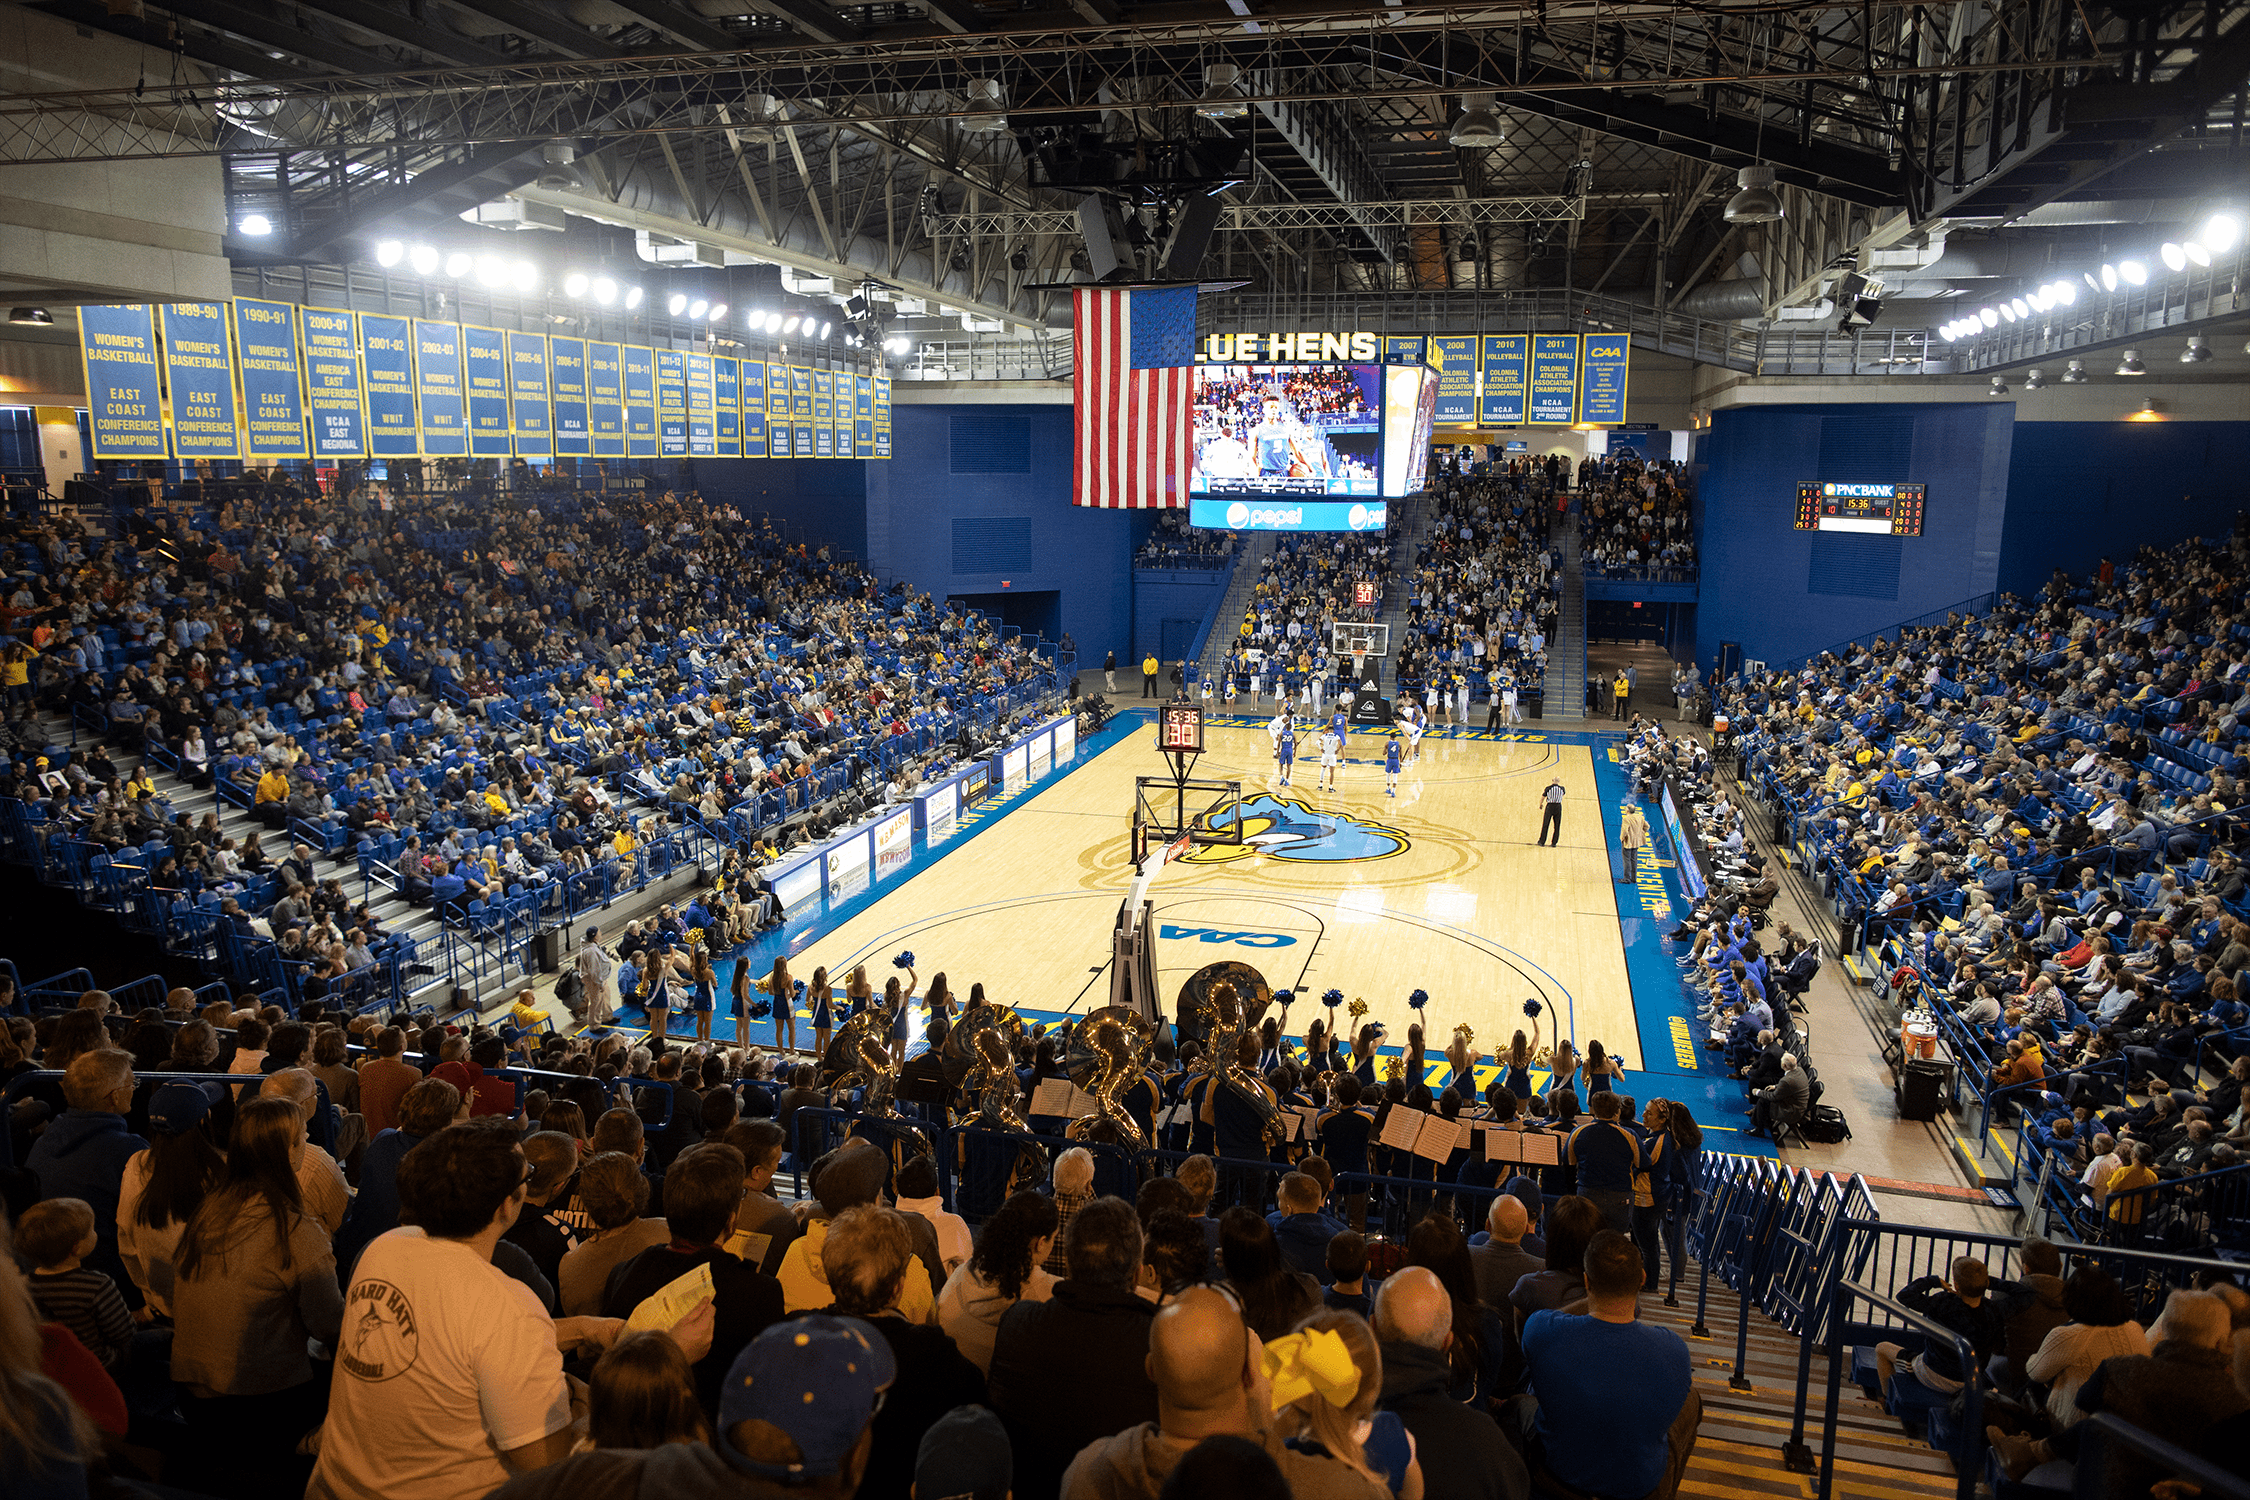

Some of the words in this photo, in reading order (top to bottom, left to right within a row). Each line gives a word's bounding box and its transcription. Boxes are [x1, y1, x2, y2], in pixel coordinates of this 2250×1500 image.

[172, 304, 218, 319] 1989-90
[244, 309, 286, 325] 1990-91
[309, 316, 347, 331] 2000-01
[94, 333, 144, 348] WOMEN'S
[312, 335, 348, 347] WOMEN'S
[368, 337, 404, 351] 2001-02
[1194, 333, 1259, 361] UE
[1269, 332, 1376, 361] HENS
[1546, 340, 1565, 348] 2011
[175, 340, 220, 354] WOMEN'S
[248, 345, 288, 358] WOMEN'S
[307, 347, 355, 359] BASKETBALL
[422, 342, 454, 355] 2002-03
[1591, 348, 1621, 357] CAA
[88, 349, 153, 364] BASKETBALL
[470, 347, 500, 360] 2004-05
[1441, 353, 1474, 361] OLLEYBALL
[1537, 352, 1574, 360] VOLLEYBALL
[170, 355, 228, 369] BASKETBALL
[243, 359, 296, 372] BASKETBALL
[316, 364, 350, 376] AMERICA
[372, 370, 406, 381] WOMEN'S
[324, 376, 343, 387] EAST
[425, 373, 455, 384] WOMEN'S
[473, 377, 501, 388] WOMEN'S
[110, 388, 140, 400] EAST
[311, 387, 358, 399] CONFERENCE
[369, 382, 412, 394] BASKETBALL
[422, 385, 461, 396] BASKETBALL
[470, 388, 506, 399] BASKETBALL
[190, 392, 216, 403] EAST
[261, 394, 286, 404] EAST
[107, 404, 146, 416] COAST
[314, 399, 358, 410] CHAMPIONS
[187, 407, 221, 418] COAST
[259, 408, 291, 418] COAST
[382, 414, 403, 423] WNIT
[97, 419, 159, 431] CONFERENCE
[326, 416, 350, 427] NCAA
[434, 415, 452, 424] WNIT
[480, 417, 499, 426] WNIT
[177, 421, 233, 433] CONFERENCE
[251, 422, 301, 432] CONFERENCE
[329, 428, 348, 438] EAST
[101, 434, 158, 446] CHAMPIONS
[181, 435, 233, 447] CHAMPIONS
[254, 435, 301, 446] CHAMPIONS
[322, 439, 358, 449] REGIONAL
[1828, 505, 1836, 514] 10
[1848, 499, 1869, 508] 15:36
[1251, 507, 1302, 528] pepsi
[1885, 508, 1891, 516] 6
[1357, 591, 1371, 602] 30
[1168, 711, 1198, 723] 15:36
[1169, 724, 1193, 745] 30
[1636, 871, 1671, 911] CENTER
[1160, 924, 1297, 948] CAA
[350, 1283, 387, 1306] HARD
[386, 1289, 416, 1338] HATT
